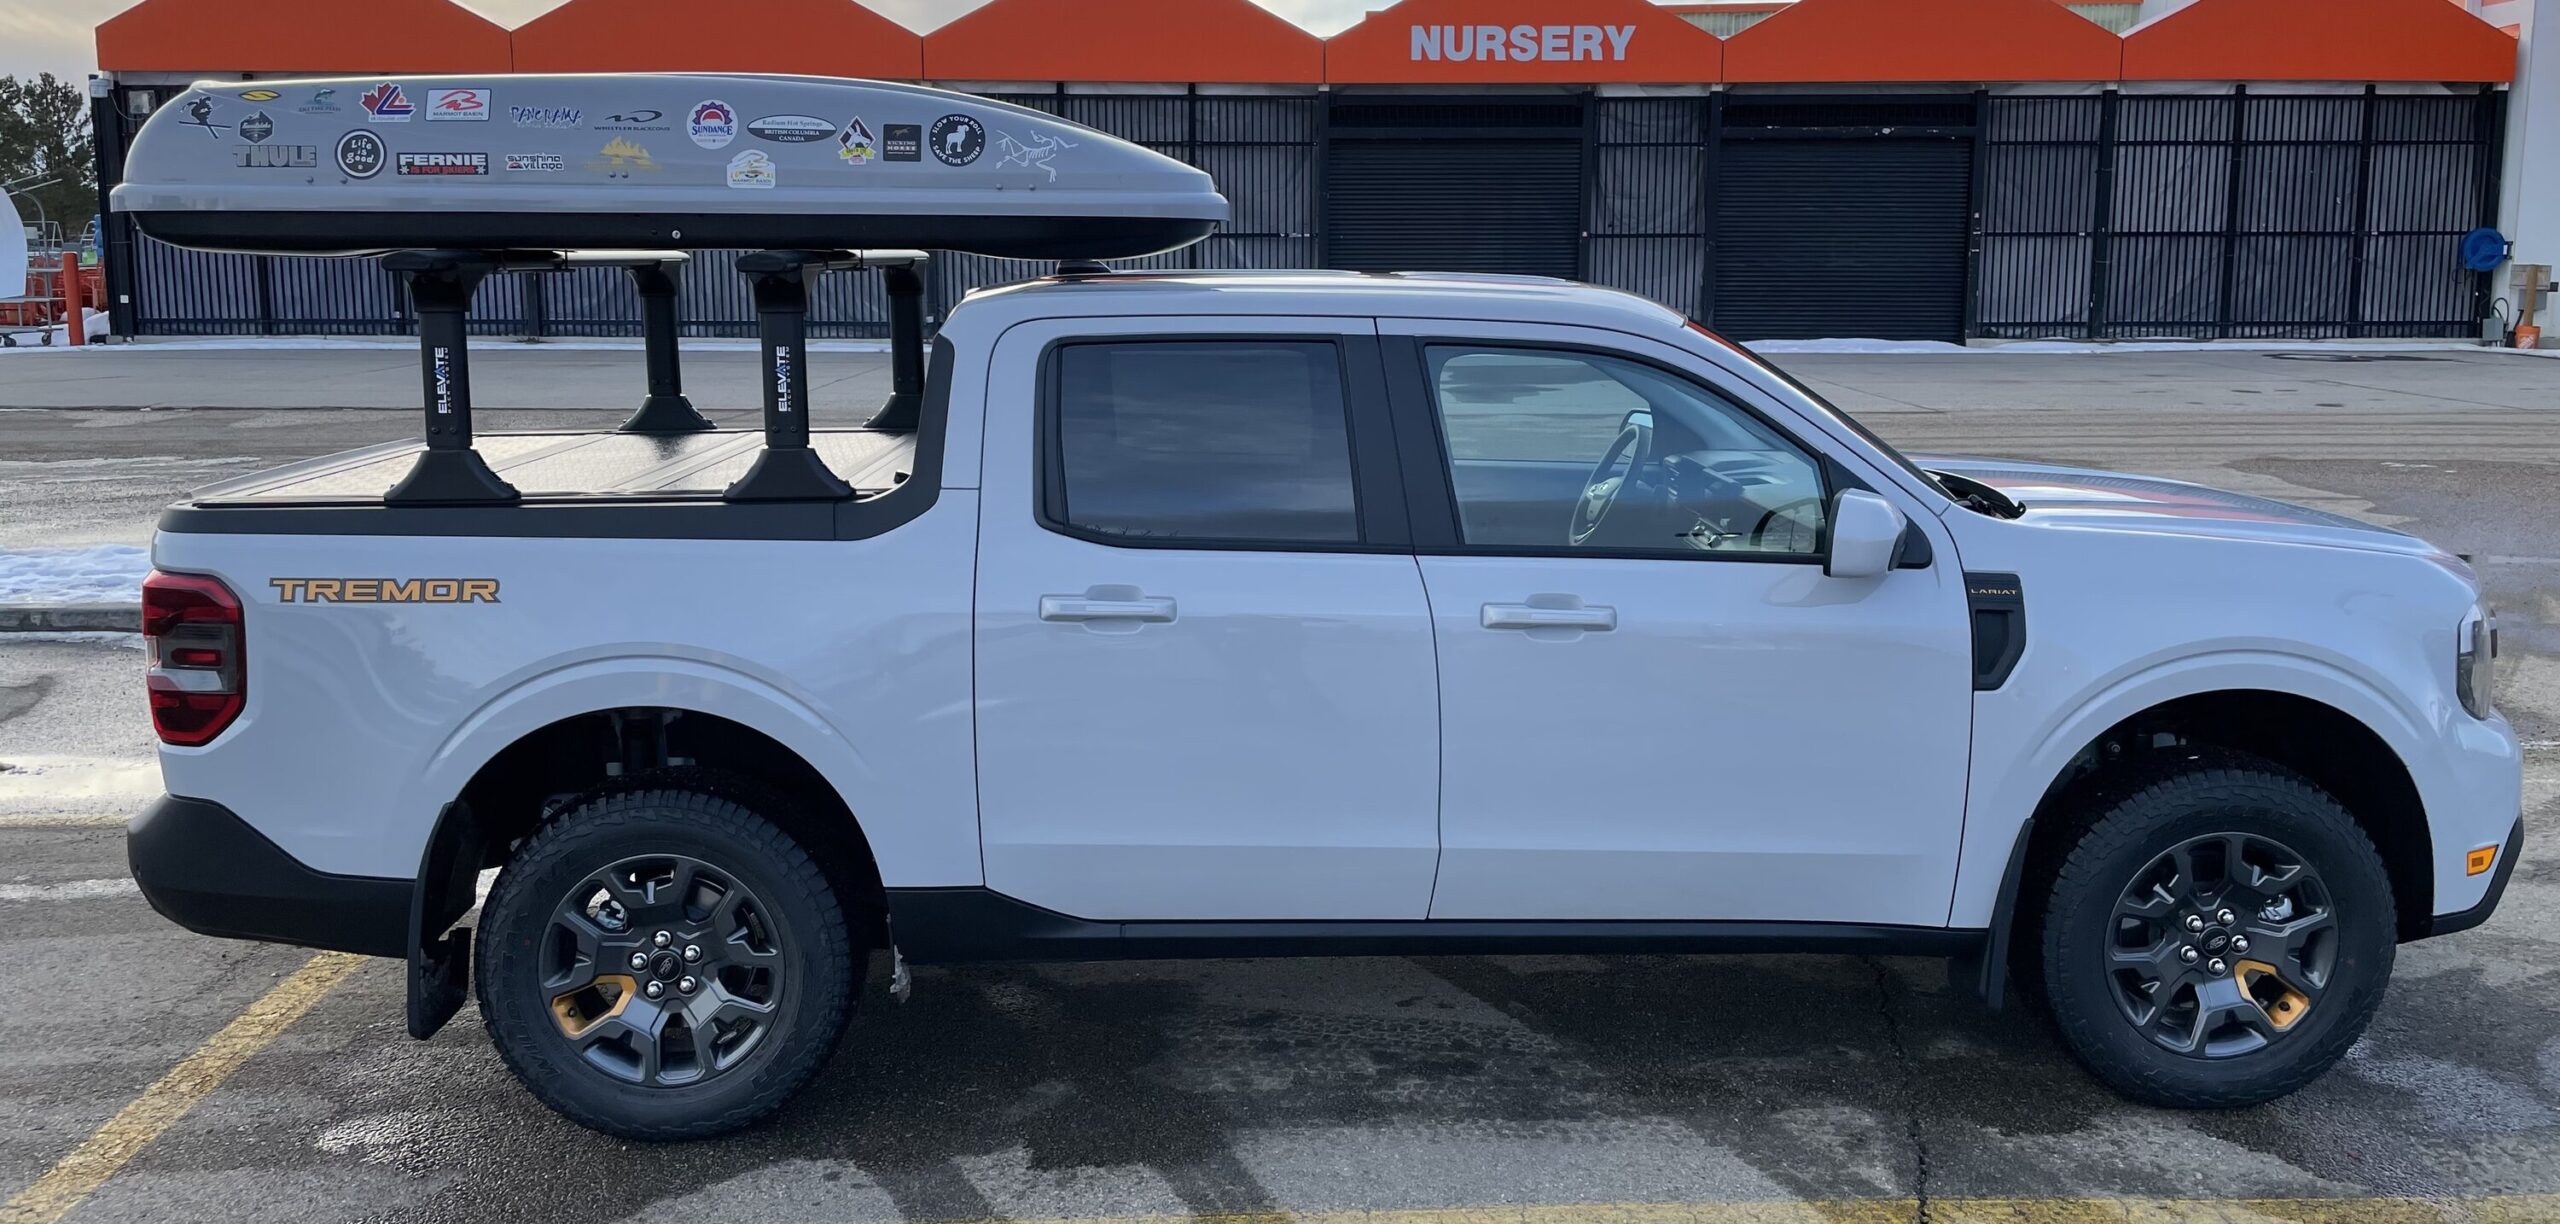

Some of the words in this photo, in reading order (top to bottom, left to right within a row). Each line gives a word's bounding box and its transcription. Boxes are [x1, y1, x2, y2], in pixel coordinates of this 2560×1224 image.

[1411, 24, 1636, 61] NURSERY
[800, 120, 823, 128] Springs
[932, 118, 947, 134] SLOW
[949, 115, 969, 123] YOUR
[969, 120, 983, 135] ROLL
[692, 125, 733, 136] SUNDANCE
[351, 138, 372, 150] Life
[233, 144, 317, 168] THULE
[357, 147, 367, 156] is
[932, 145, 948, 160] SAVE
[963, 146, 981, 163] SHEEP
[399, 154, 486, 166] FERNIE
[507, 154, 561, 162] sunshine
[410, 166, 420, 174] IS
[422, 166, 440, 174] FOR
[442, 166, 476, 174] SKIERS
[523, 160, 563, 170] village
[434, 347, 448, 414] ELEVATE
[775, 346, 787, 412] ELEVATE
[269, 578, 501, 603] TREMOR
